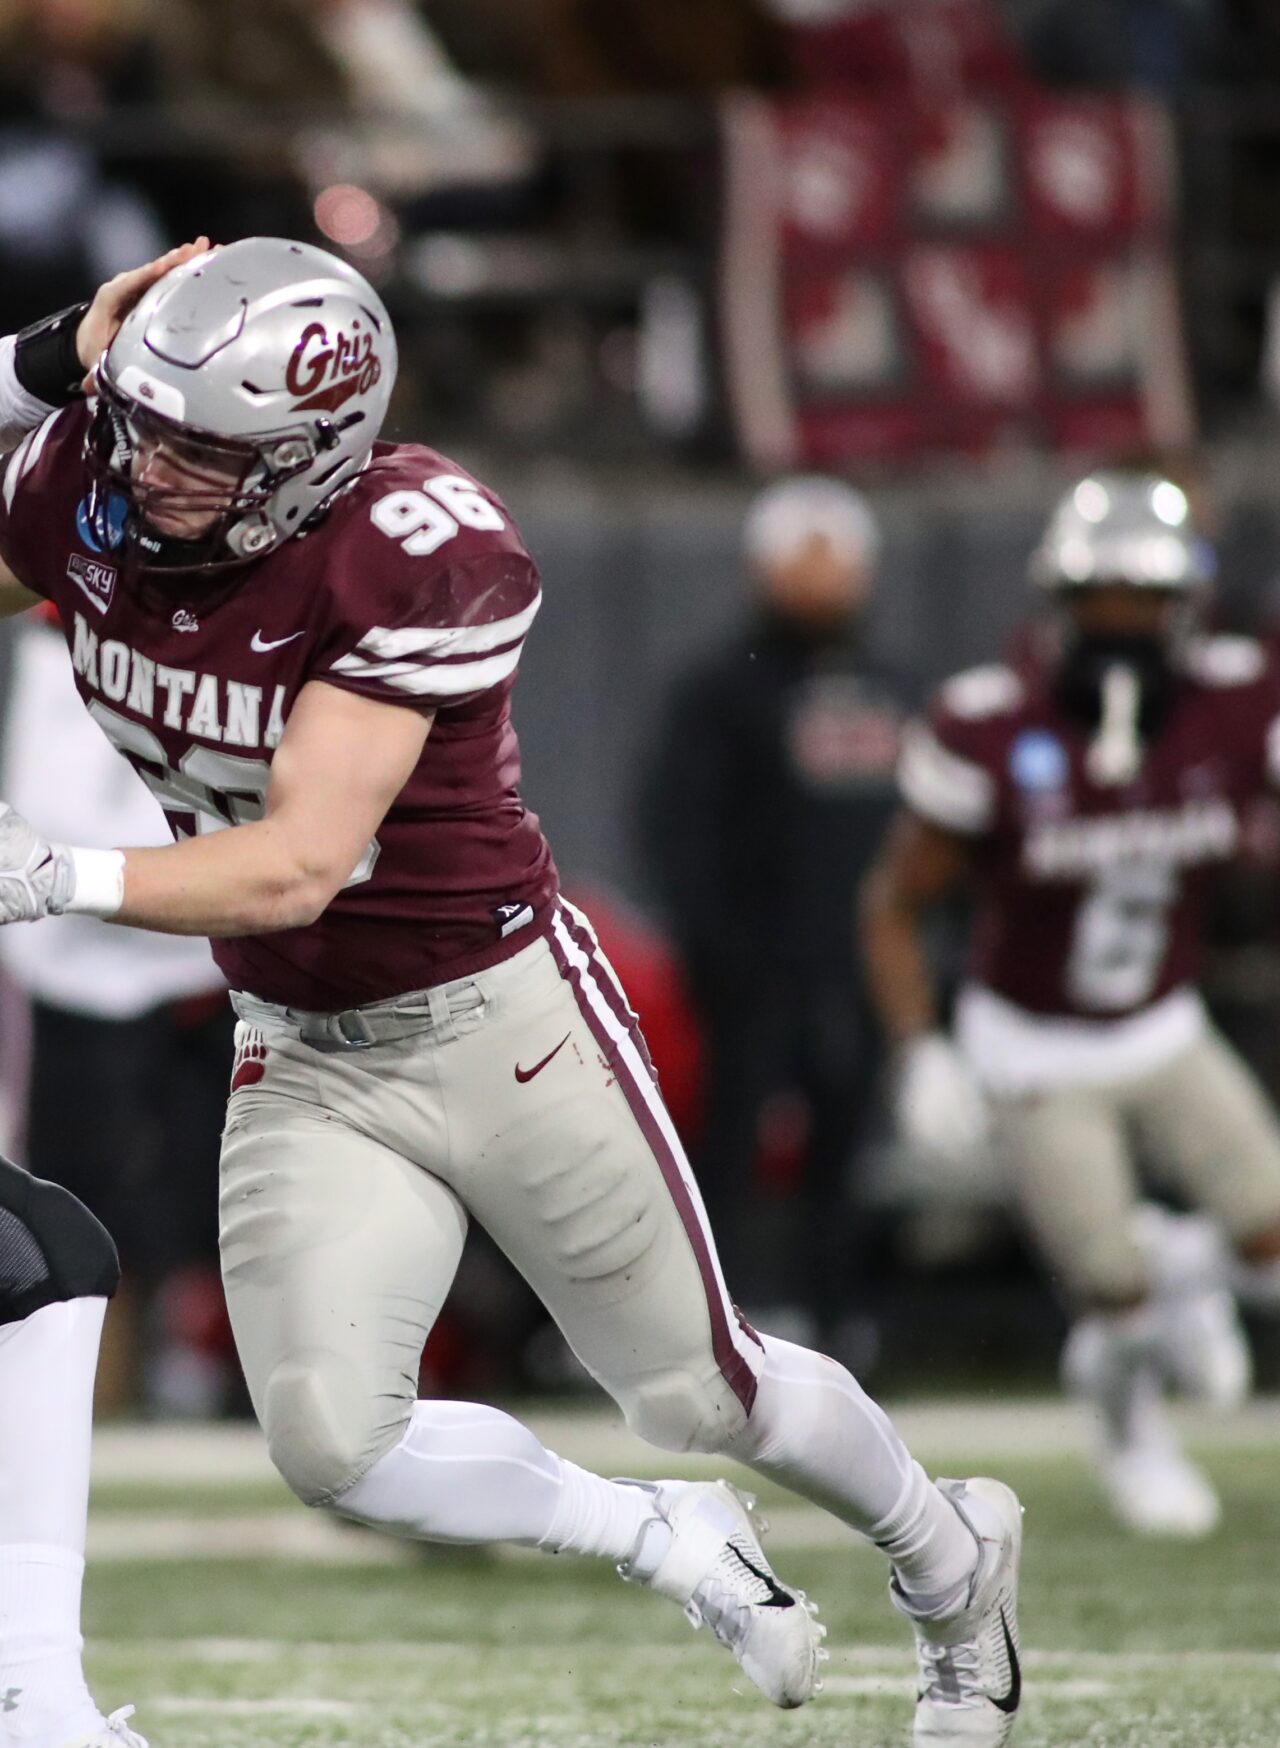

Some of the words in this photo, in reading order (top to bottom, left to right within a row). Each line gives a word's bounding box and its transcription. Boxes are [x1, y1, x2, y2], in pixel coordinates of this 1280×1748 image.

[286, 320, 381, 396] Griz
[370, 474, 505, 556] 96
[85, 564, 113, 594] SKY
[72, 611, 287, 749] MONTANA
